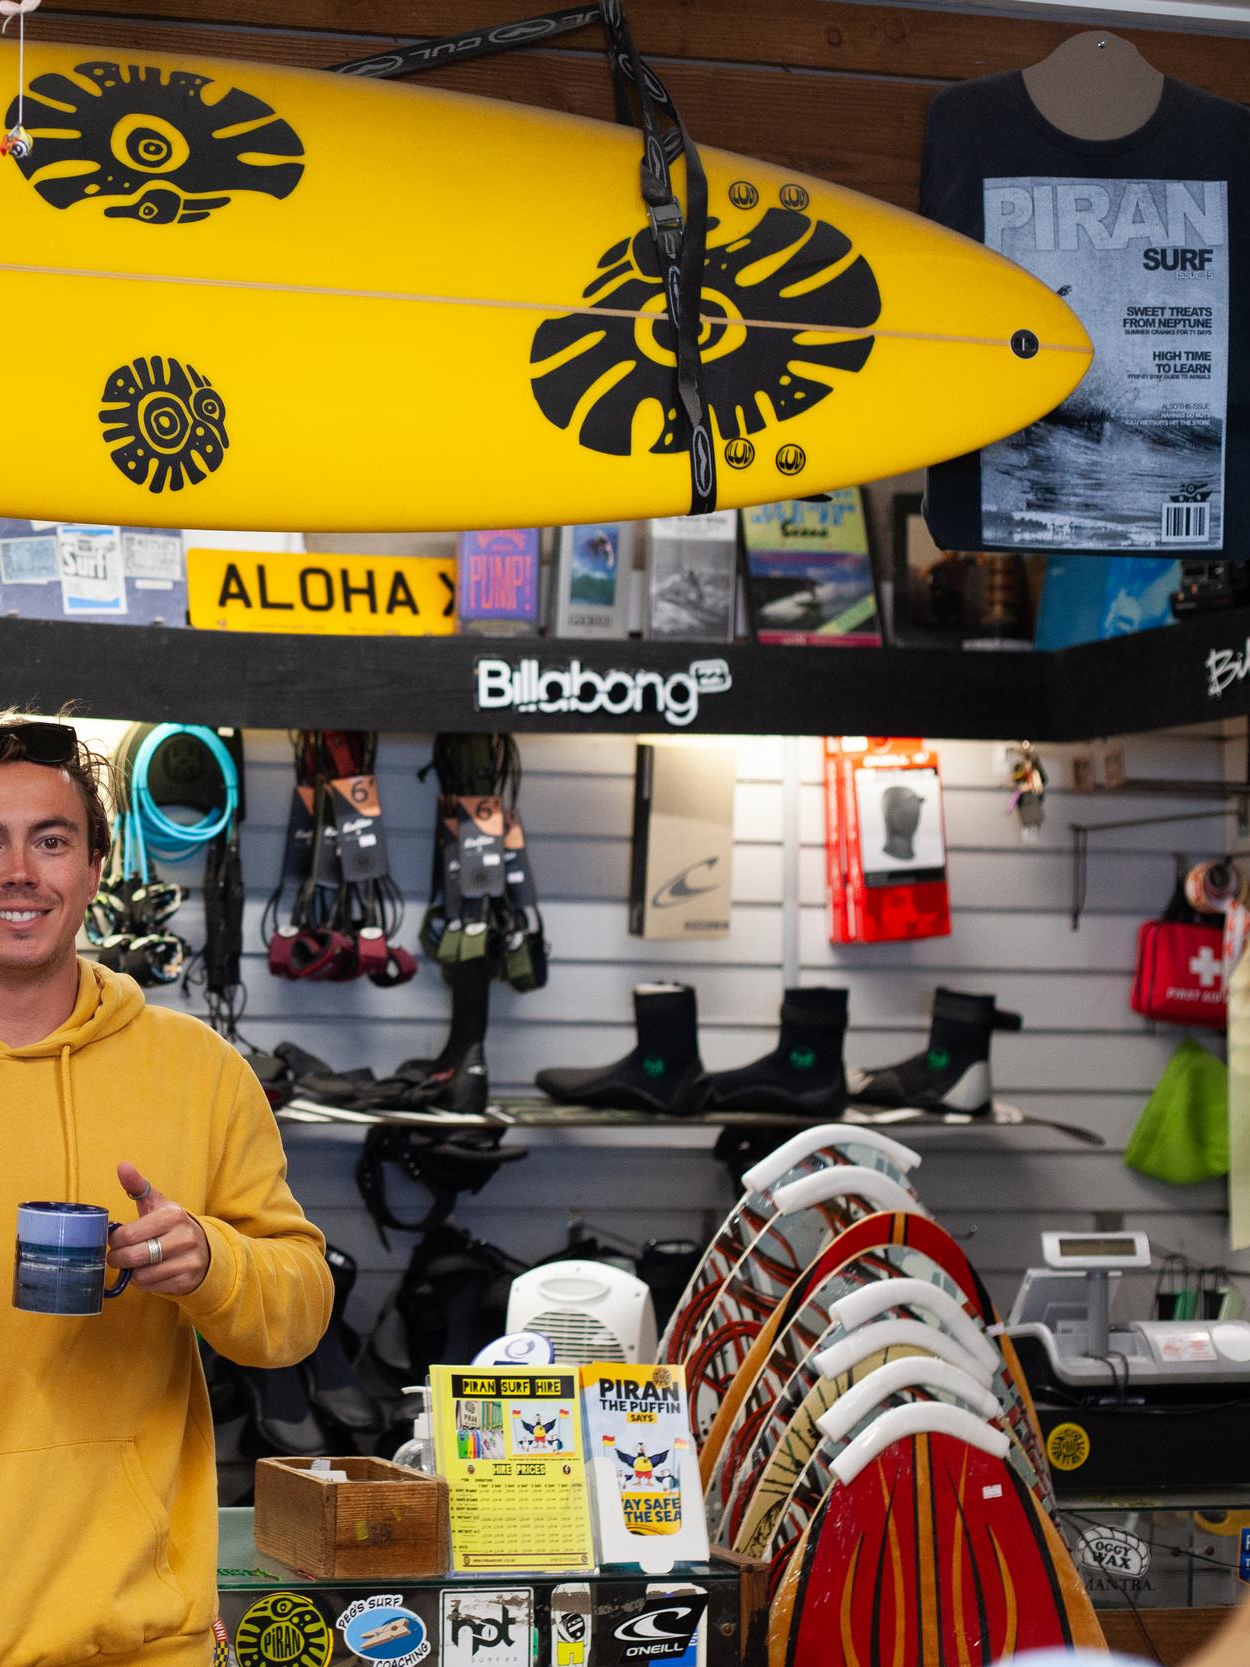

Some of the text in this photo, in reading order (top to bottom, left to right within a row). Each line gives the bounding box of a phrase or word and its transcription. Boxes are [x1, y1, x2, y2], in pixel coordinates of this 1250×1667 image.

[984, 182, 1224, 250] PIRAN
[1143, 248, 1214, 271] SURF
[1127, 307, 1212, 317] SWEET TREATS
[1123, 318, 1212, 329] FROM NEPTUNE
[1152, 351, 1212, 361] HIGH TIME
[1155, 363, 1212, 373] TO LEARN
[219, 563, 419, 617] ALOHA
[477, 658, 699, 727] Billabong
[463, 1380, 560, 1393] PIRAN SURF HIRE
[599, 1378, 680, 1402] PIRAN
[599, 1400, 681, 1413] THE PUFFIN
[630, 1414, 654, 1422] SAYS
[493, 1464, 546, 1475] HIRE PRICES
[622, 1498, 681, 1511] AY SAFE
[624, 1511, 681, 1523] THE SEA
[1095, 1541, 1132, 1557] OGGY
[1092, 1551, 1132, 1570] WAX
[338, 1596, 401, 1630] PEG'S SURF
[375, 1644, 429, 1667] COACHING
